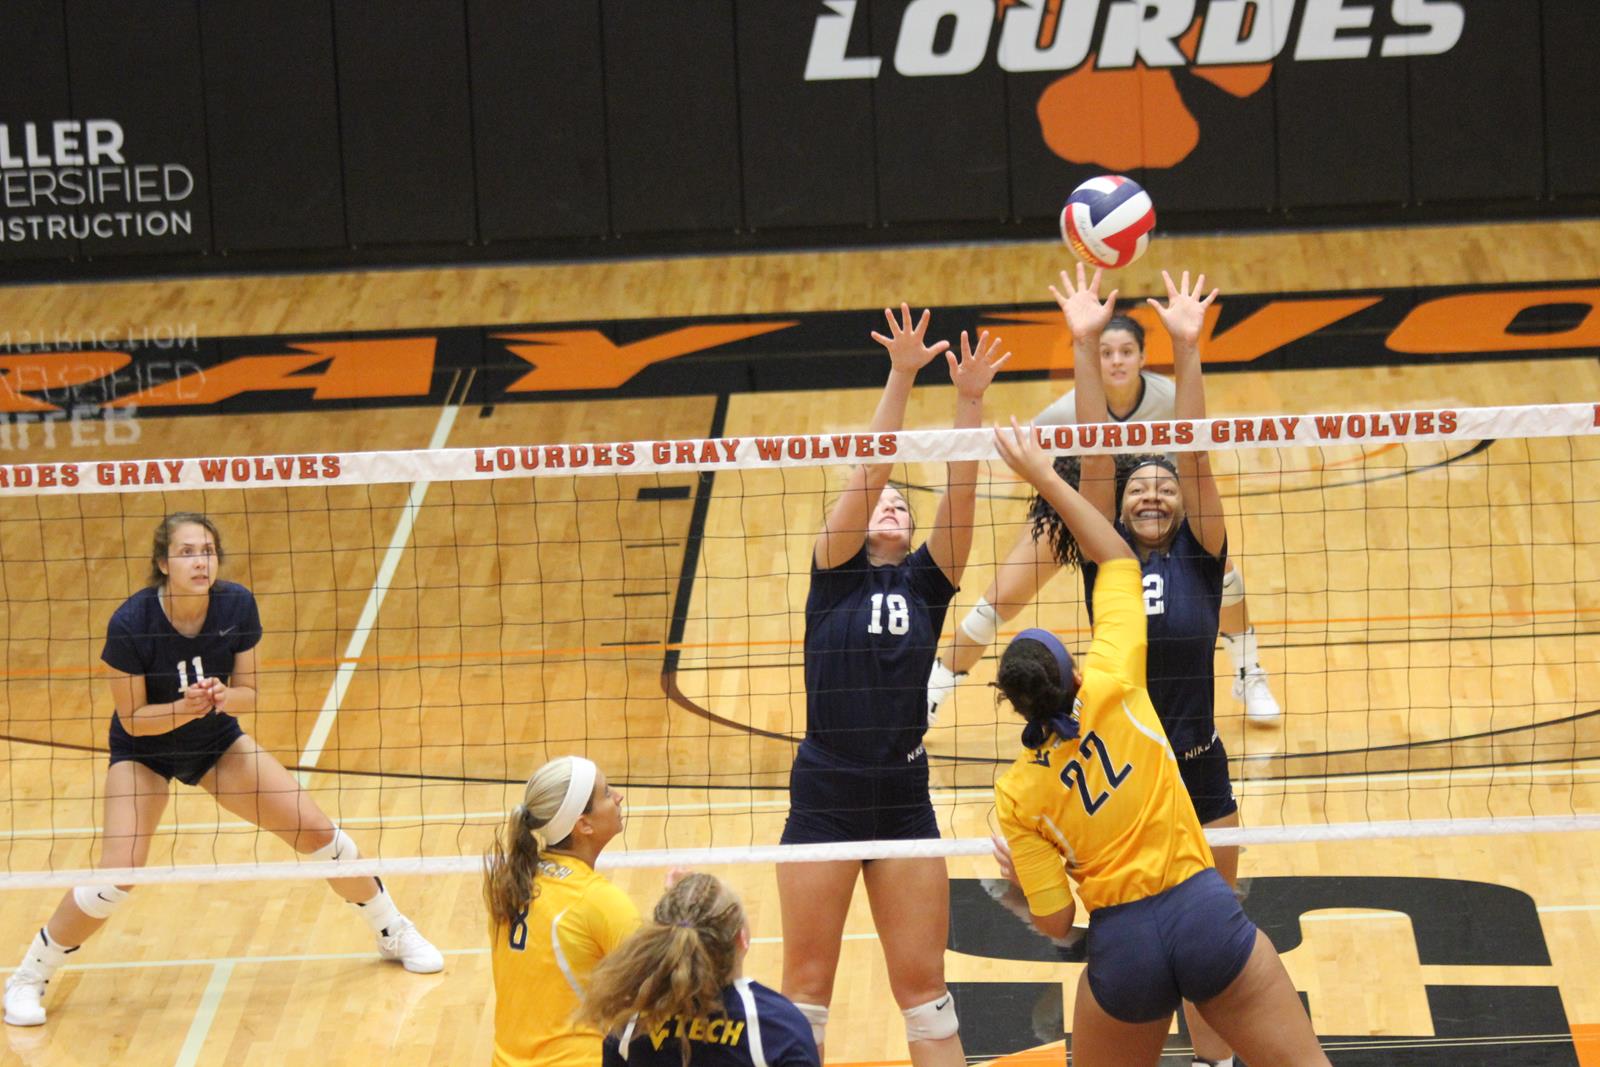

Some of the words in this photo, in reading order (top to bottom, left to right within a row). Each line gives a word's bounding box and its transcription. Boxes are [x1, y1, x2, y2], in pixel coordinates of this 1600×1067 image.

[804, 0, 1466, 81] LOURDES
[0, 119, 125, 168] LLER
[0, 163, 194, 207] ERSIFIED
[0, 211, 192, 242] STRUCTION
[1035, 421, 1194, 450] LOURDES
[1210, 416, 1300, 444] GRAY
[1315, 410, 1459, 439] WOLVES
[97, 460, 184, 486] GRAY
[199, 455, 341, 483] WOLVES
[475, 442, 635, 473] LOURDES
[652, 439, 740, 465] GRAY
[754, 433, 898, 461] WOLVES
[867, 593, 910, 635] 18
[176, 656, 205, 693] 11
[1060, 730, 1132, 816] 22
